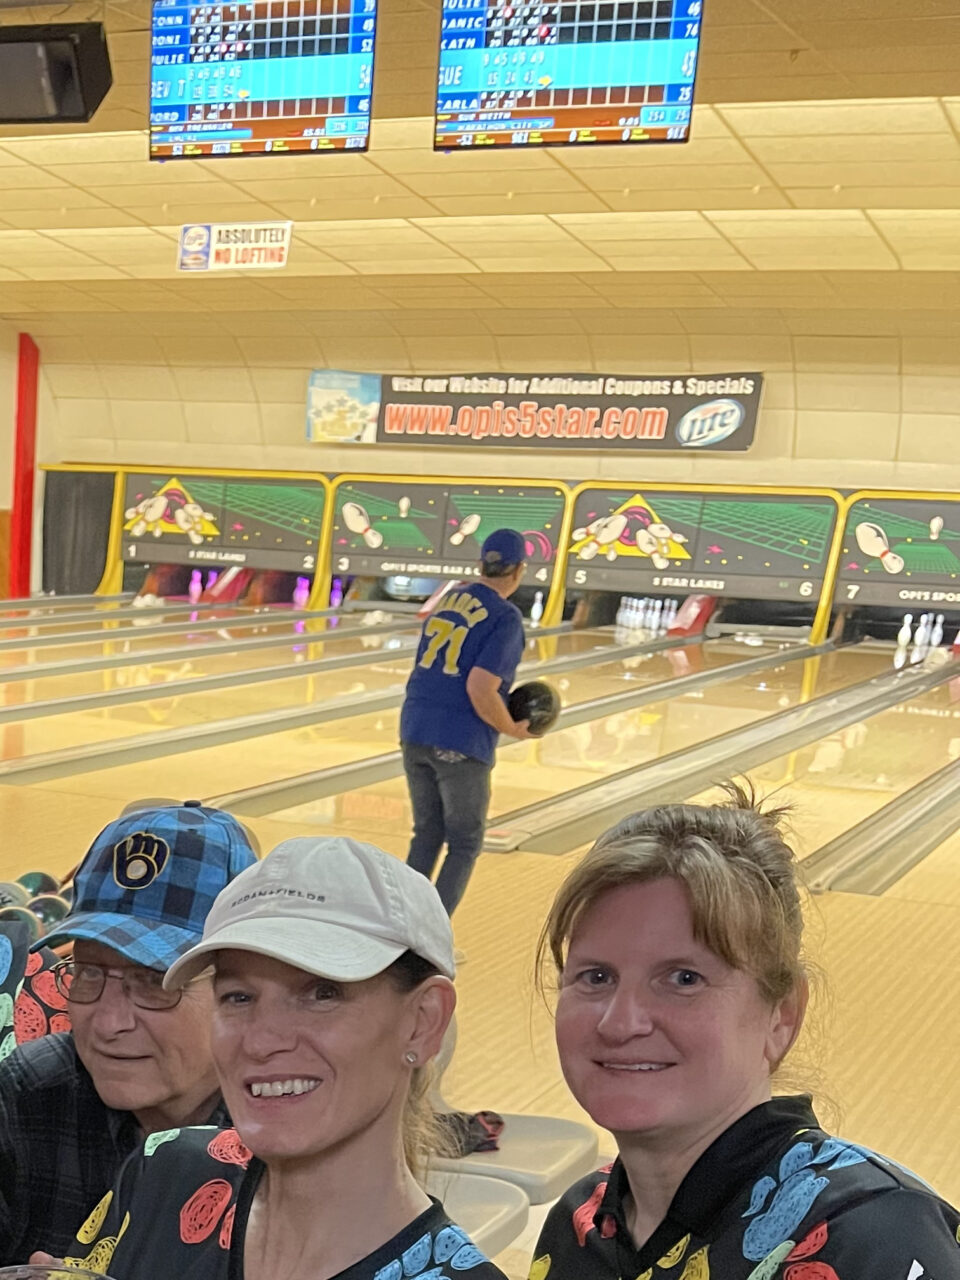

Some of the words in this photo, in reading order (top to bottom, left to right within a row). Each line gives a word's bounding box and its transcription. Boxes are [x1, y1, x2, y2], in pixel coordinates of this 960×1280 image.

[215, 248, 231, 264] NO
[235, 246, 285, 264] LOFTING
[392, 377, 423, 392] Visit
[424, 379, 448, 393] our
[449, 377, 507, 394] Website
[508, 378, 529, 394] for
[530, 378, 603, 394] Additional
[605, 378, 671, 396] Coupons
[672, 380, 685, 394] &
[686, 378, 754, 396] Specials
[385, 400, 669, 440] www.opis5star.com
[128, 544, 137, 558] 1
[303, 555, 315, 569] 2
[338, 557, 349, 571] 3
[535, 567, 548, 582] 4
[574, 569, 587, 584] 5
[662, 577, 688, 587] STAR
[690, 578, 725, 589] LANES
[799, 581, 813, 596] 6
[847, 584, 860, 599] 7
[931, 591, 960, 602] SPO
[418, 616, 470, 675] 71
